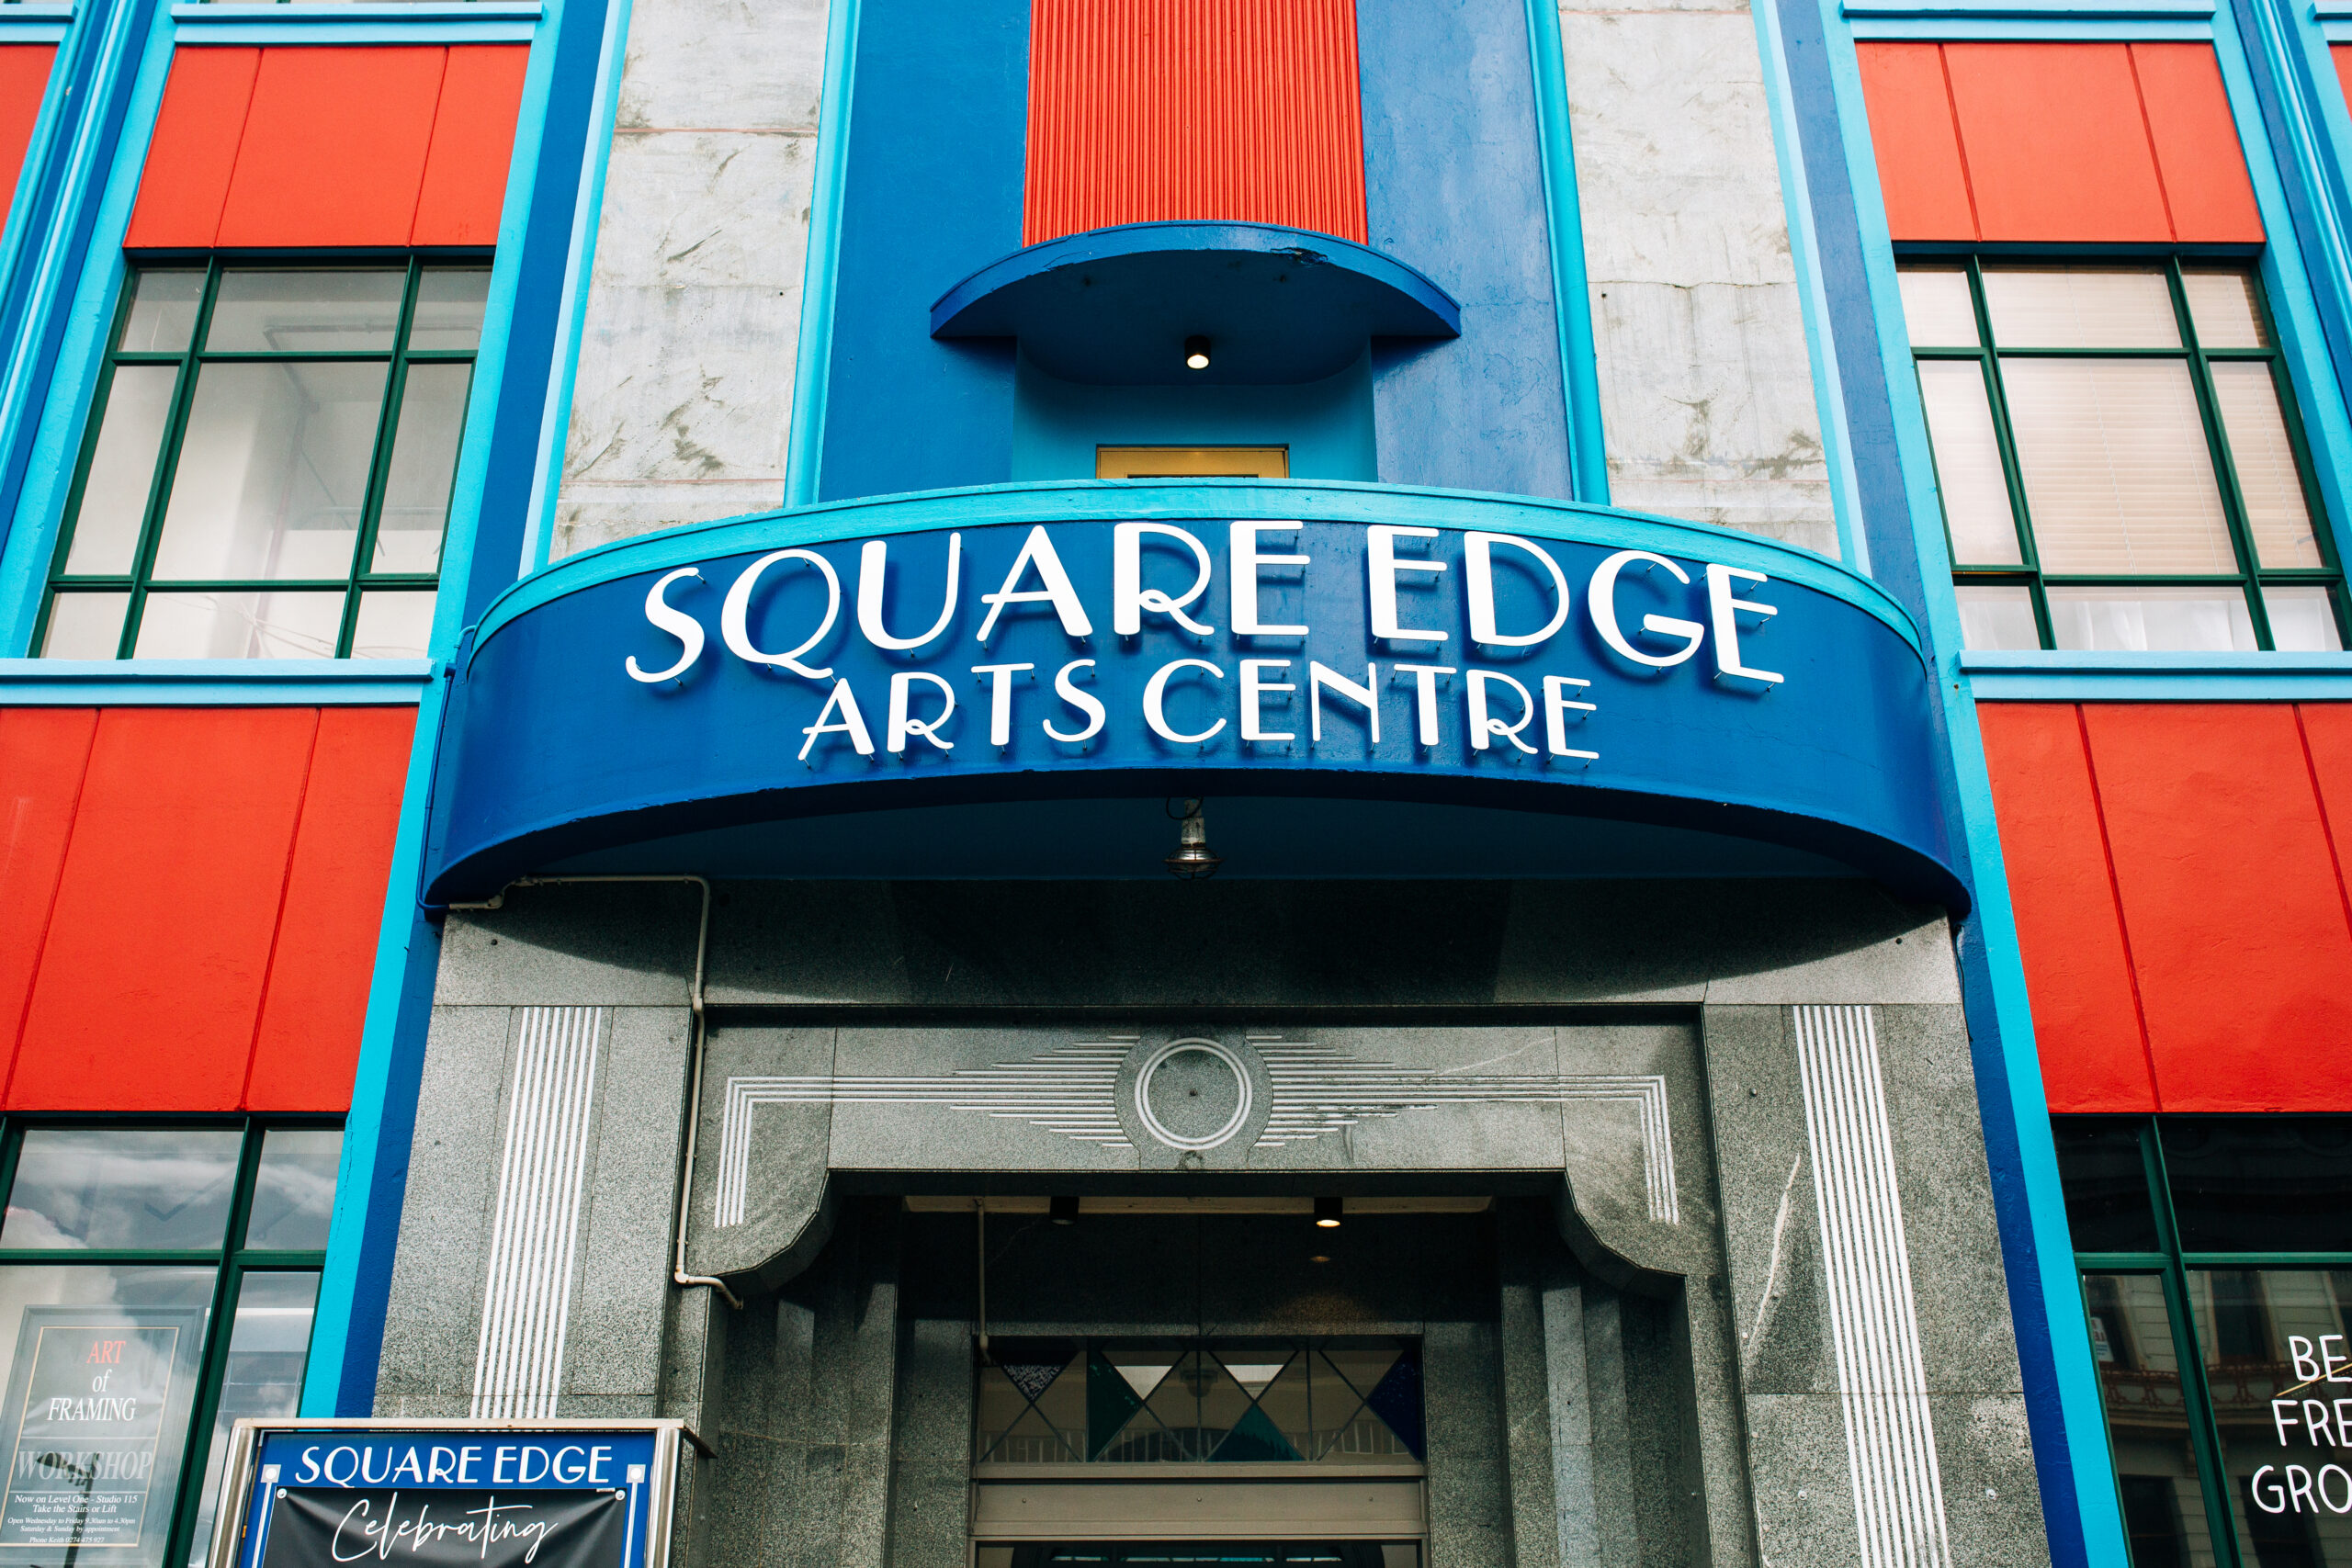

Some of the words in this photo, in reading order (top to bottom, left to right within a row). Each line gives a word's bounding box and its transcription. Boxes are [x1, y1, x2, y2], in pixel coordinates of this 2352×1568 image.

[626, 521, 1310, 682] SQUARE
[1367, 525, 1784, 683] EDGE
[797, 659, 1106, 761] ARTS
[1142, 659, 1600, 760] CENTRE
[86, 1340, 126, 1364] ART
[2289, 1335, 2352, 1382] BE
[92, 1369, 112, 1393] of
[47, 1398, 137, 1421] FRAMING
[18, 1450, 154, 1481] WORKSHOP
[295, 1445, 482, 1488] SQUARE
[492, 1446, 613, 1483] EDGE
[15, 1495, 34, 1504] Now
[48, 1495, 71, 1504] Level
[72, 1495, 89, 1504] One
[96, 1495, 122, 1504] Studio
[124, 1495, 139, 1504] 115
[2252, 1464, 2352, 1514] GRO
[33, 1505, 51, 1513] Take
[53, 1505, 65, 1513] the
[68, 1505, 90, 1513] Stairs
[102, 1505, 117, 1514] Lift
[332, 1489, 560, 1563] Celebrating
